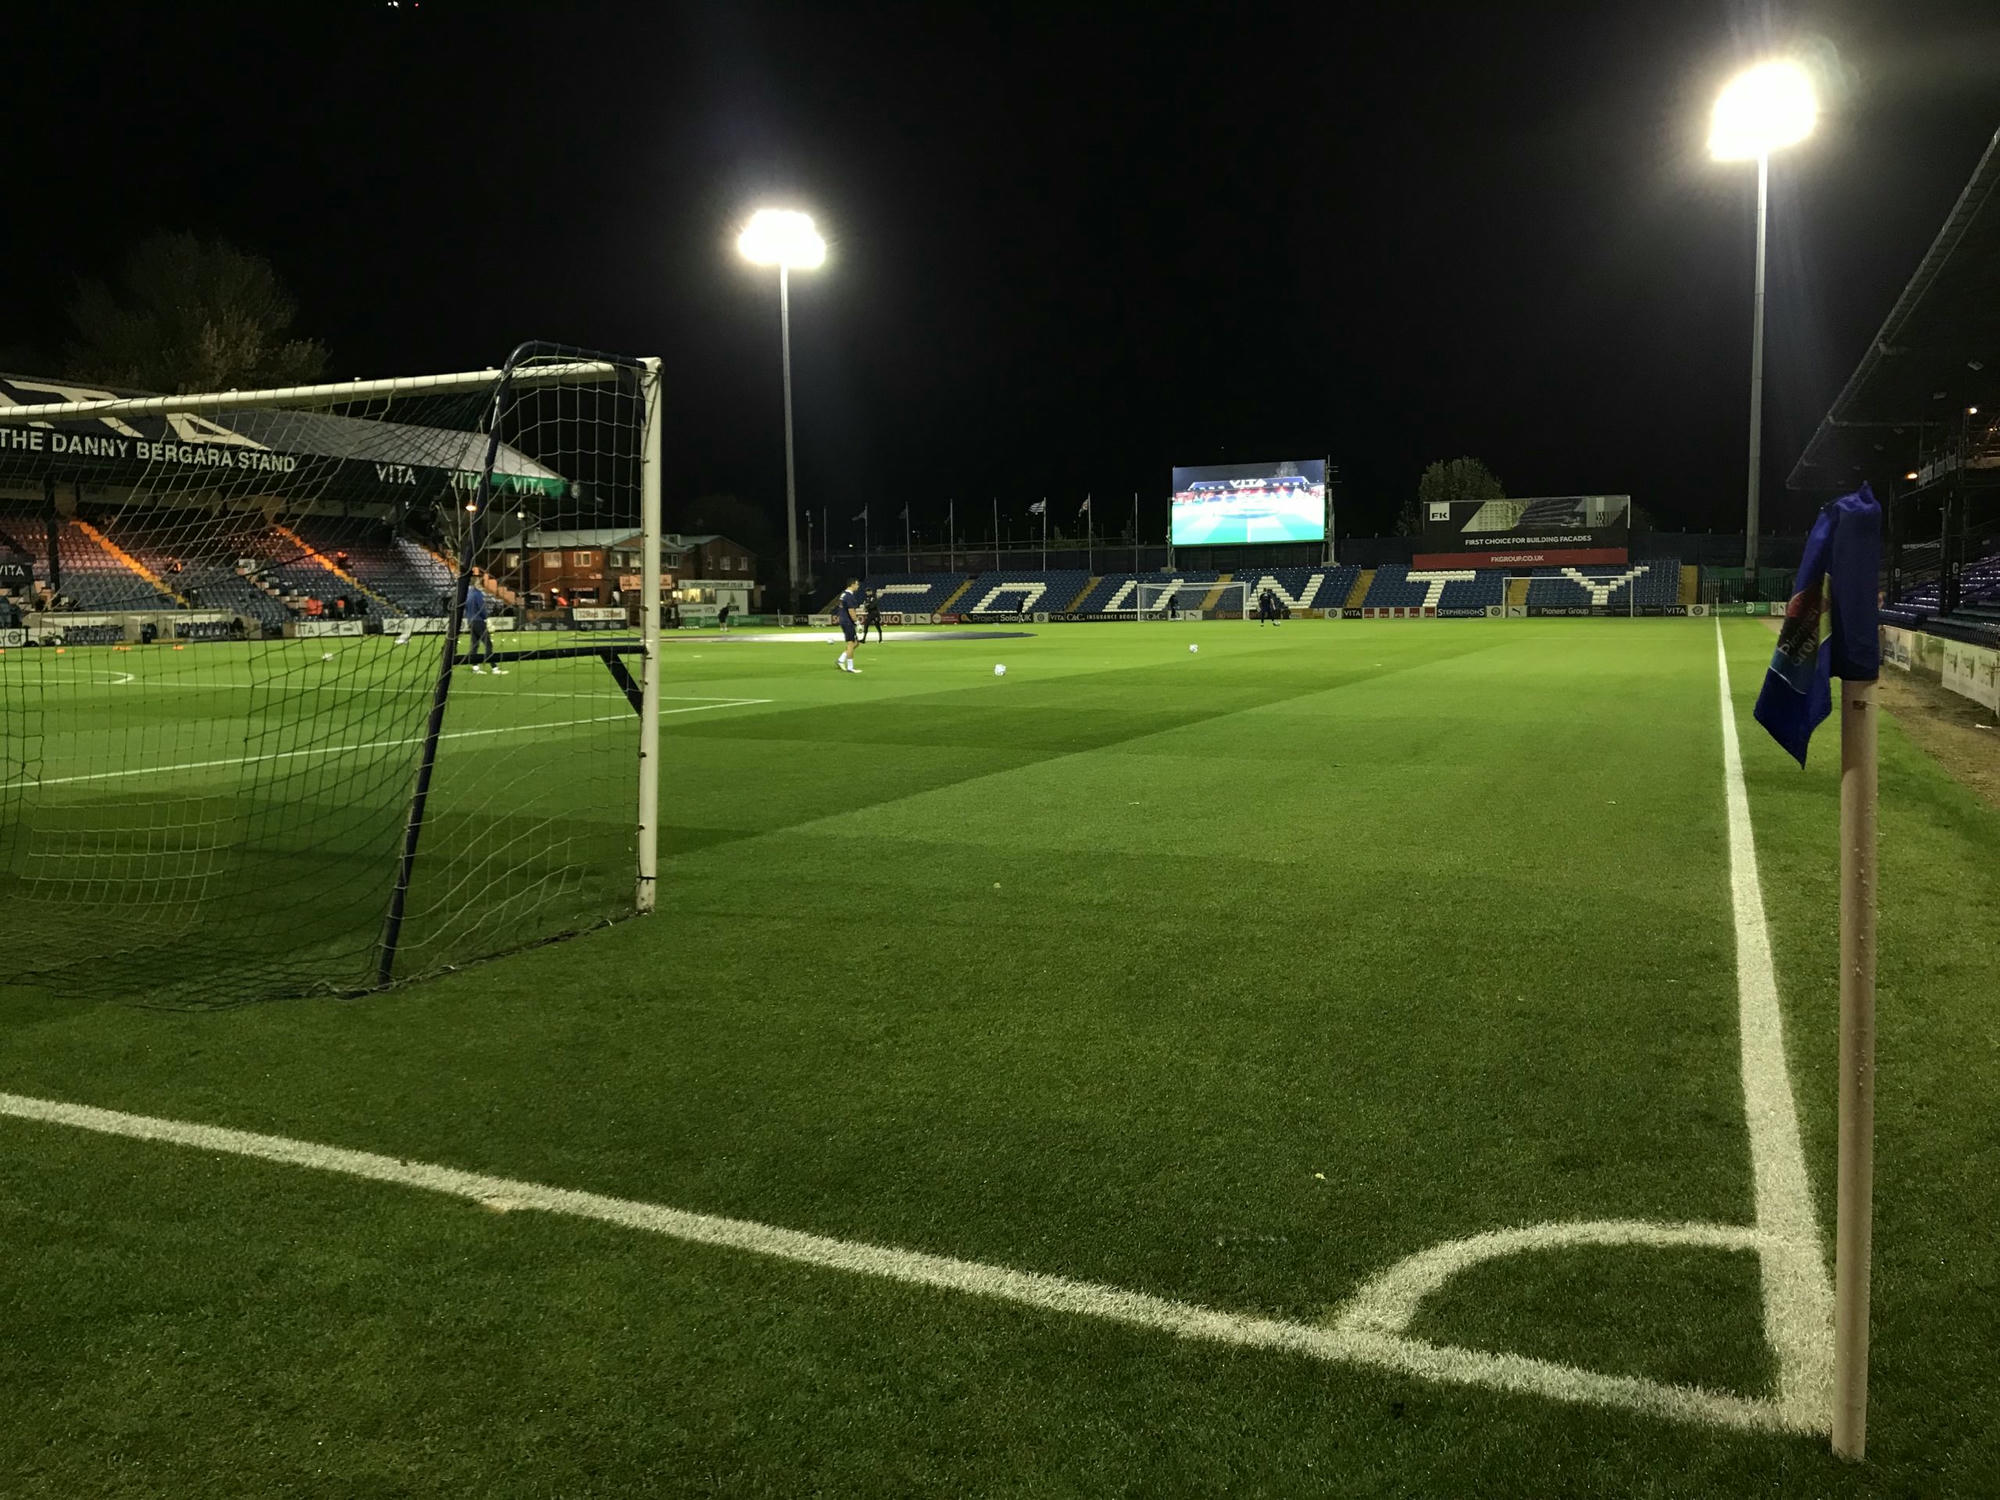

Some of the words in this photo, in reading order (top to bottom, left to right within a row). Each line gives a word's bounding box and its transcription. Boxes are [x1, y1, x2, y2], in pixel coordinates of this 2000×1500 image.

[0, 428, 43, 451] THE
[51, 433, 129, 458] DANNY
[136, 441, 233, 468] BERGARA
[238, 451, 296, 472] STAND
[375, 463, 417, 486] VITA
[512, 476, 546, 496] VITA
[1229, 478, 1267, 489] VITA
[1431, 511, 1448, 520] FK
[1465, 538, 1484, 546] FIRST
[1485, 537, 1511, 545] CHOICE
[1559, 534, 1592, 542] FACADES
[1490, 555, 1544, 563] FKGROUP.CO.UK
[1343, 608, 1361, 617] VITA
[1437, 608, 1485, 617] STEPHENSONS
[1541, 607, 1567, 615] Pioneer
[1568, 607, 1589, 616] Group
[1666, 607, 1686, 615] VITA
[972, 613, 999, 624] Project
